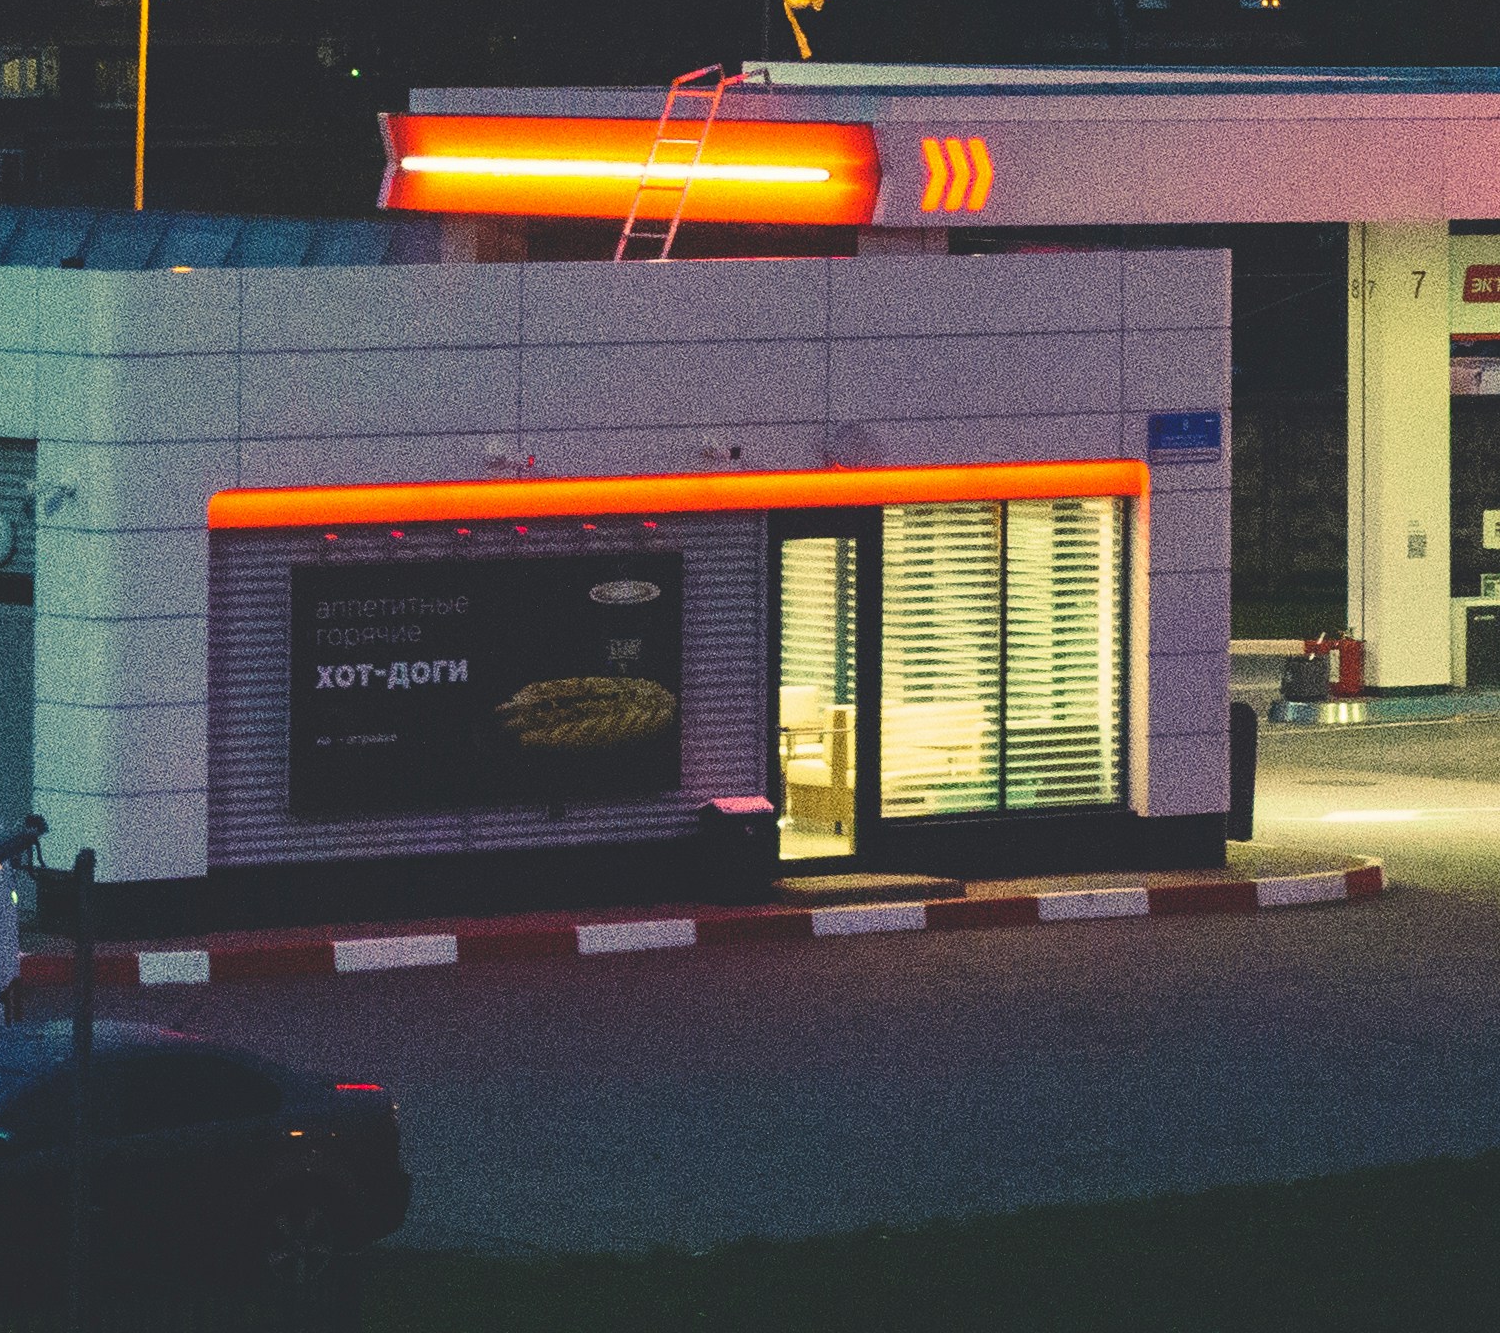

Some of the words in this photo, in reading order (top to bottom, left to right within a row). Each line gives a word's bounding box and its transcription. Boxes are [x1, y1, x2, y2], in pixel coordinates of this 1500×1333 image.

[1367, 278, 1377, 299] 7
[1411, 270, 1426, 299] 7
[315, 595, 471, 621] аппетитные
[315, 623, 423, 648] горячие
[315, 658, 470, 690] хот-доги
